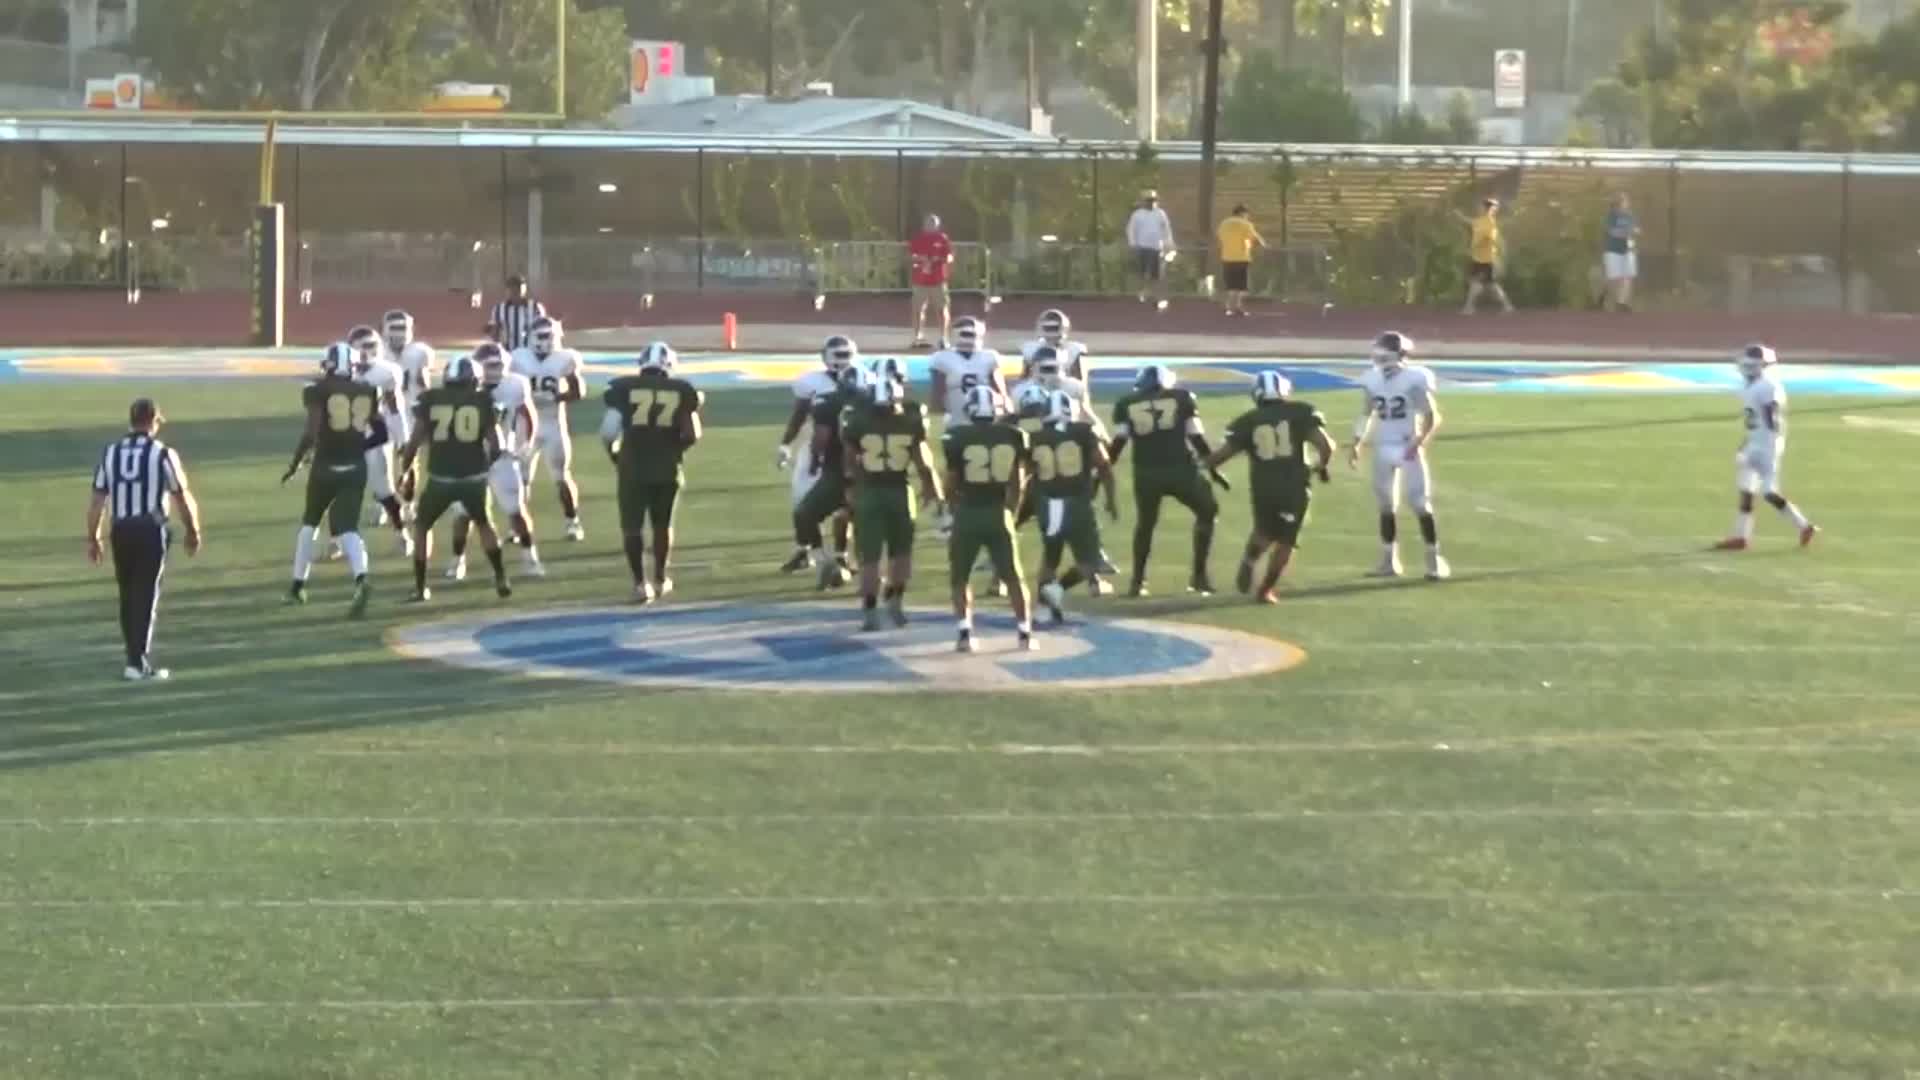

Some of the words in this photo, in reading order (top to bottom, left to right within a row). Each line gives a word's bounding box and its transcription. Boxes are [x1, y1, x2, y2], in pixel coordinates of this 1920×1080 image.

[429, 405, 481, 443] 70
[629, 389, 682, 427] 77
[119, 447, 143, 481] U
[860, 433, 913, 472] 25
